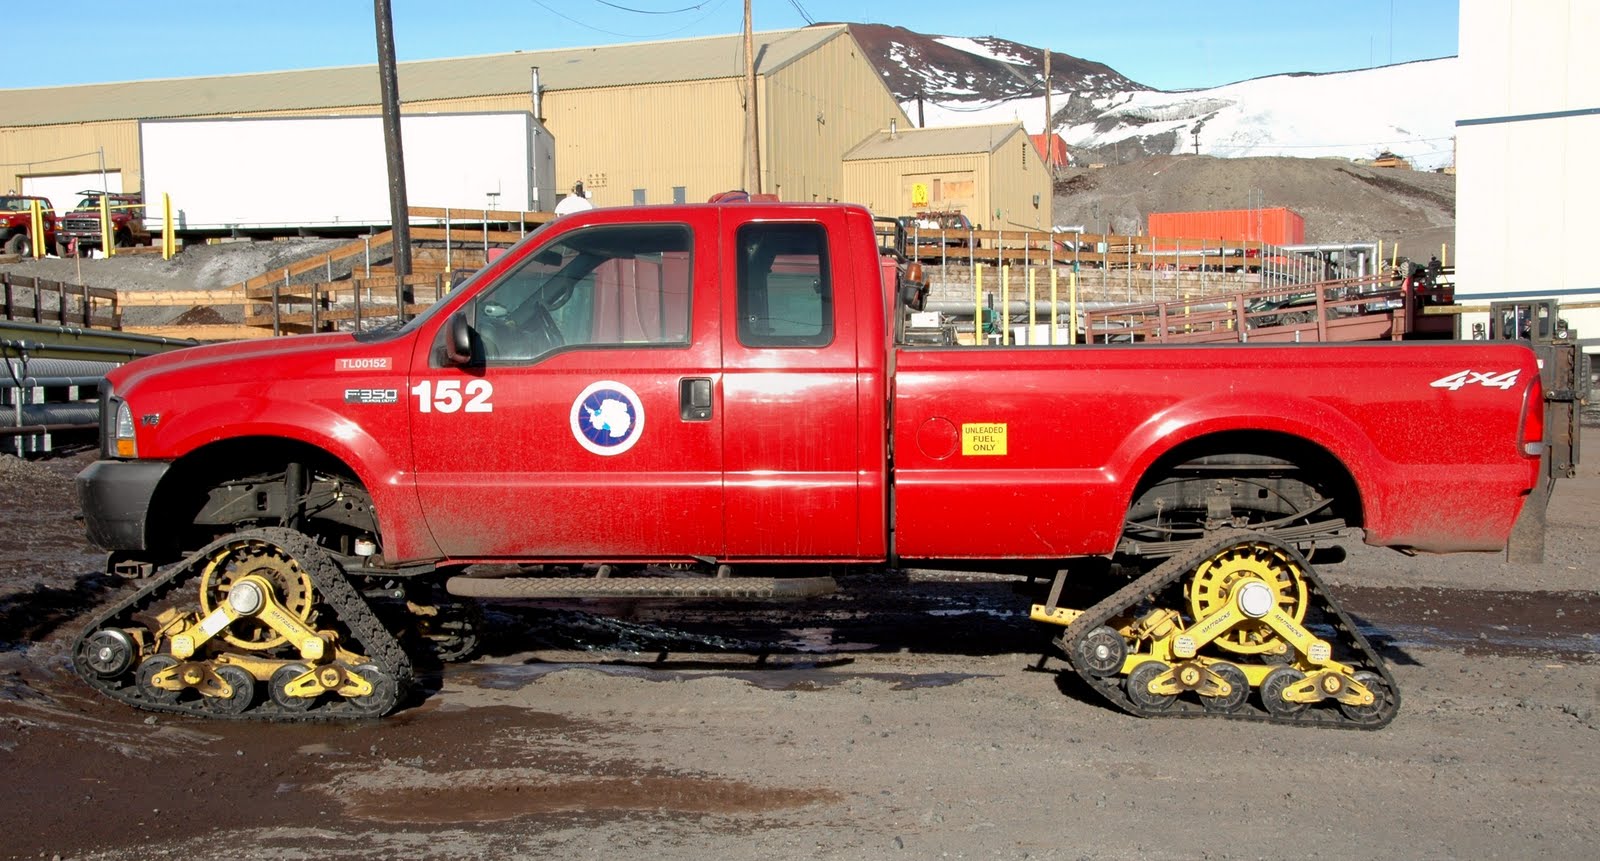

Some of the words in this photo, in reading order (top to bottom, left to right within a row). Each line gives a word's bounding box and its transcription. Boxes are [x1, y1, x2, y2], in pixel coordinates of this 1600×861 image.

[341, 358, 386, 369] TL00152
[411, 379, 494, 414] 152
[965, 426, 1004, 434] UNLEADED
[271, 610, 300, 634] MATTRACKS
[1202, 611, 1229, 632] MATTRACKS
[1275, 614, 1303, 637] MATTRACKS
